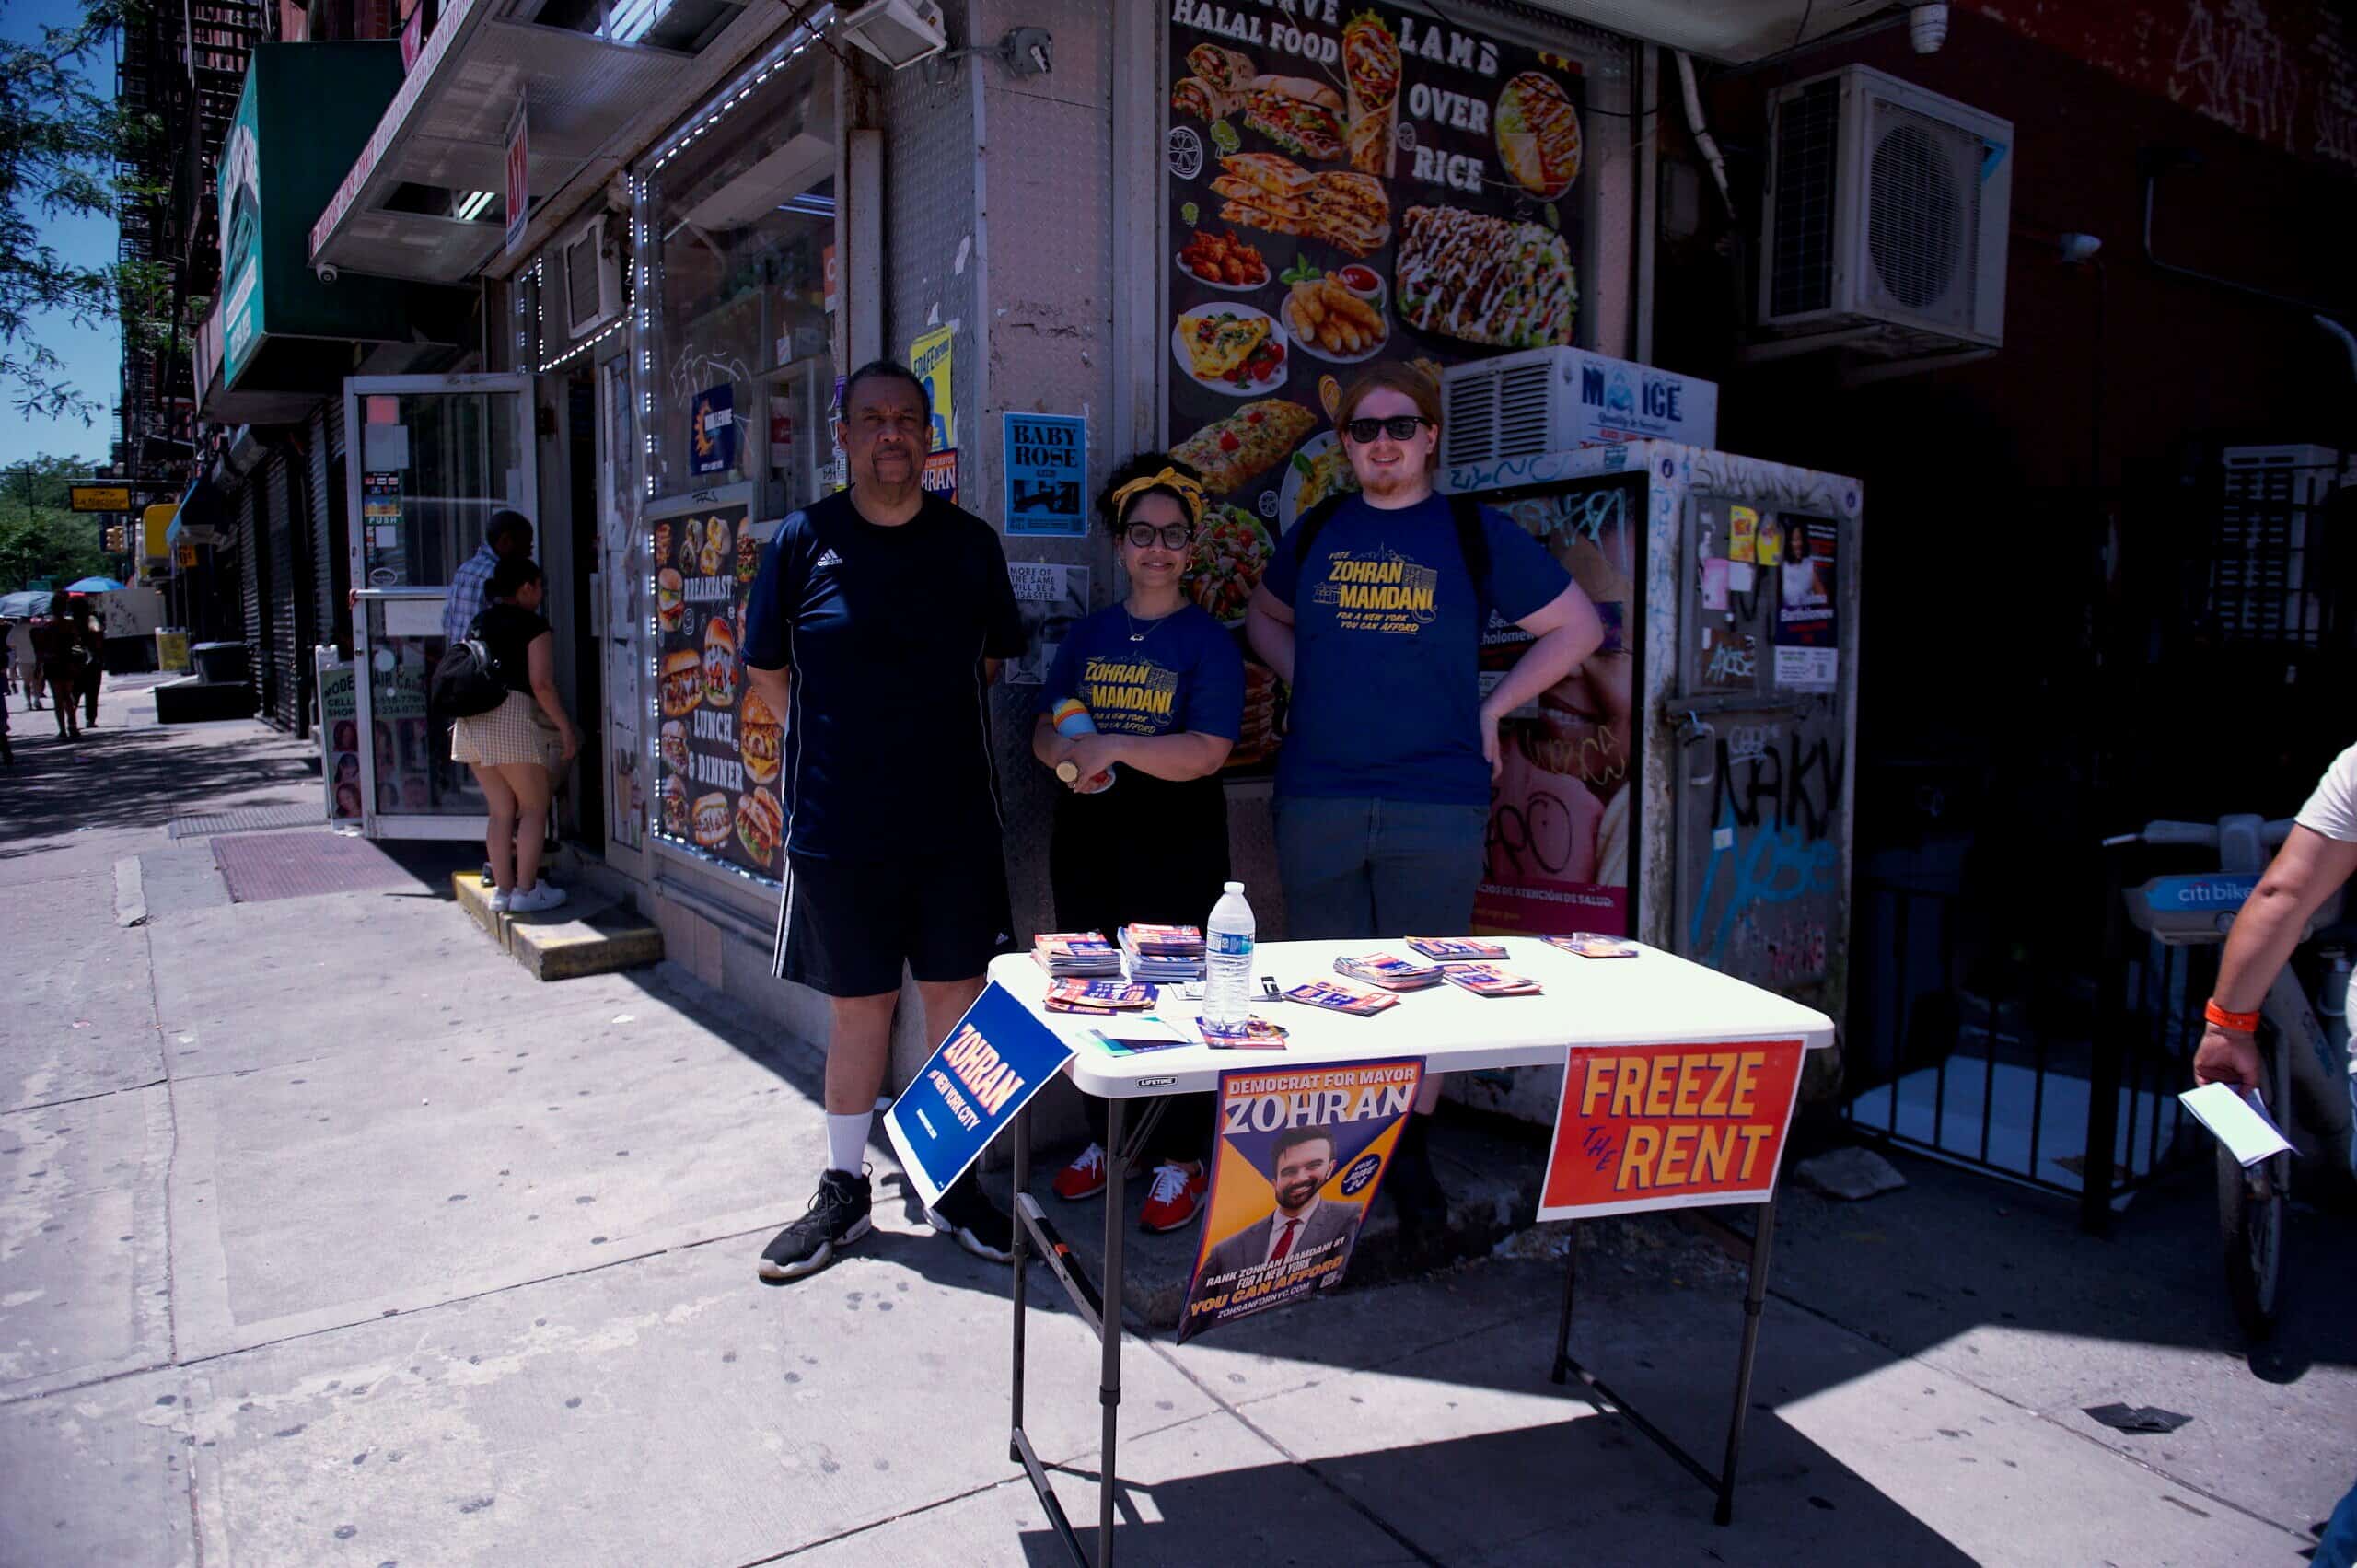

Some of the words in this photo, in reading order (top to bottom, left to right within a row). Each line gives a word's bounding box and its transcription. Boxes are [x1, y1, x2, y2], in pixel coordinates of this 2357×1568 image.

[1172, 0, 1262, 45] HALAL
[1270, 22, 1340, 64] FOOD
[1399, 17, 1501, 77] LAMB
[1409, 82, 1490, 135] OVER
[1411, 145, 1485, 194] RICE
[1643, 380, 1683, 422] ICE
[1013, 425, 1076, 447] BABY
[1016, 446, 1078, 468] ROSE
[1329, 561, 1405, 584] ZOHRAN
[1016, 591, 1054, 600] ISASTER
[1338, 584, 1434, 611] MAMDANI
[1084, 662, 1151, 685] ZOHRAN
[1091, 684, 1175, 714] MAMDANI
[694, 710, 733, 743] LUNCH
[697, 753, 744, 792] DINNER
[2178, 884, 2210, 902] citi
[943, 1022, 1026, 1117] ZOHRAN
[1229, 1075, 1319, 1096] DEMOCRAT
[1324, 1072, 1356, 1087] FOR
[1359, 1067, 1416, 1086] MAYOR
[1580, 1051, 1766, 1119] FREEZE
[944, 1086, 968, 1116] YORK
[958, 1106, 981, 1132] CITY
[1222, 1082, 1416, 1135] ZOHRAN
[1583, 1126, 1618, 1172] THE
[1614, 1123, 1775, 1192] RENT
[1206, 1270, 1237, 1288] RANK
[1238, 1257, 1283, 1278] ZOHRAN
[1283, 1240, 1333, 1264] MAMDANI
[1236, 1275, 1255, 1290] FOR
[1256, 1273, 1264, 1284] A
[1264, 1267, 1286, 1282] NEW
[1287, 1258, 1312, 1274] YORK
[1190, 1294, 1229, 1317] YOU
[1231, 1282, 1272, 1306] CAN
[1274, 1255, 1344, 1289] AFFORD
[1216, 1282, 1311, 1319] ZOHRANFORNYC.COM
